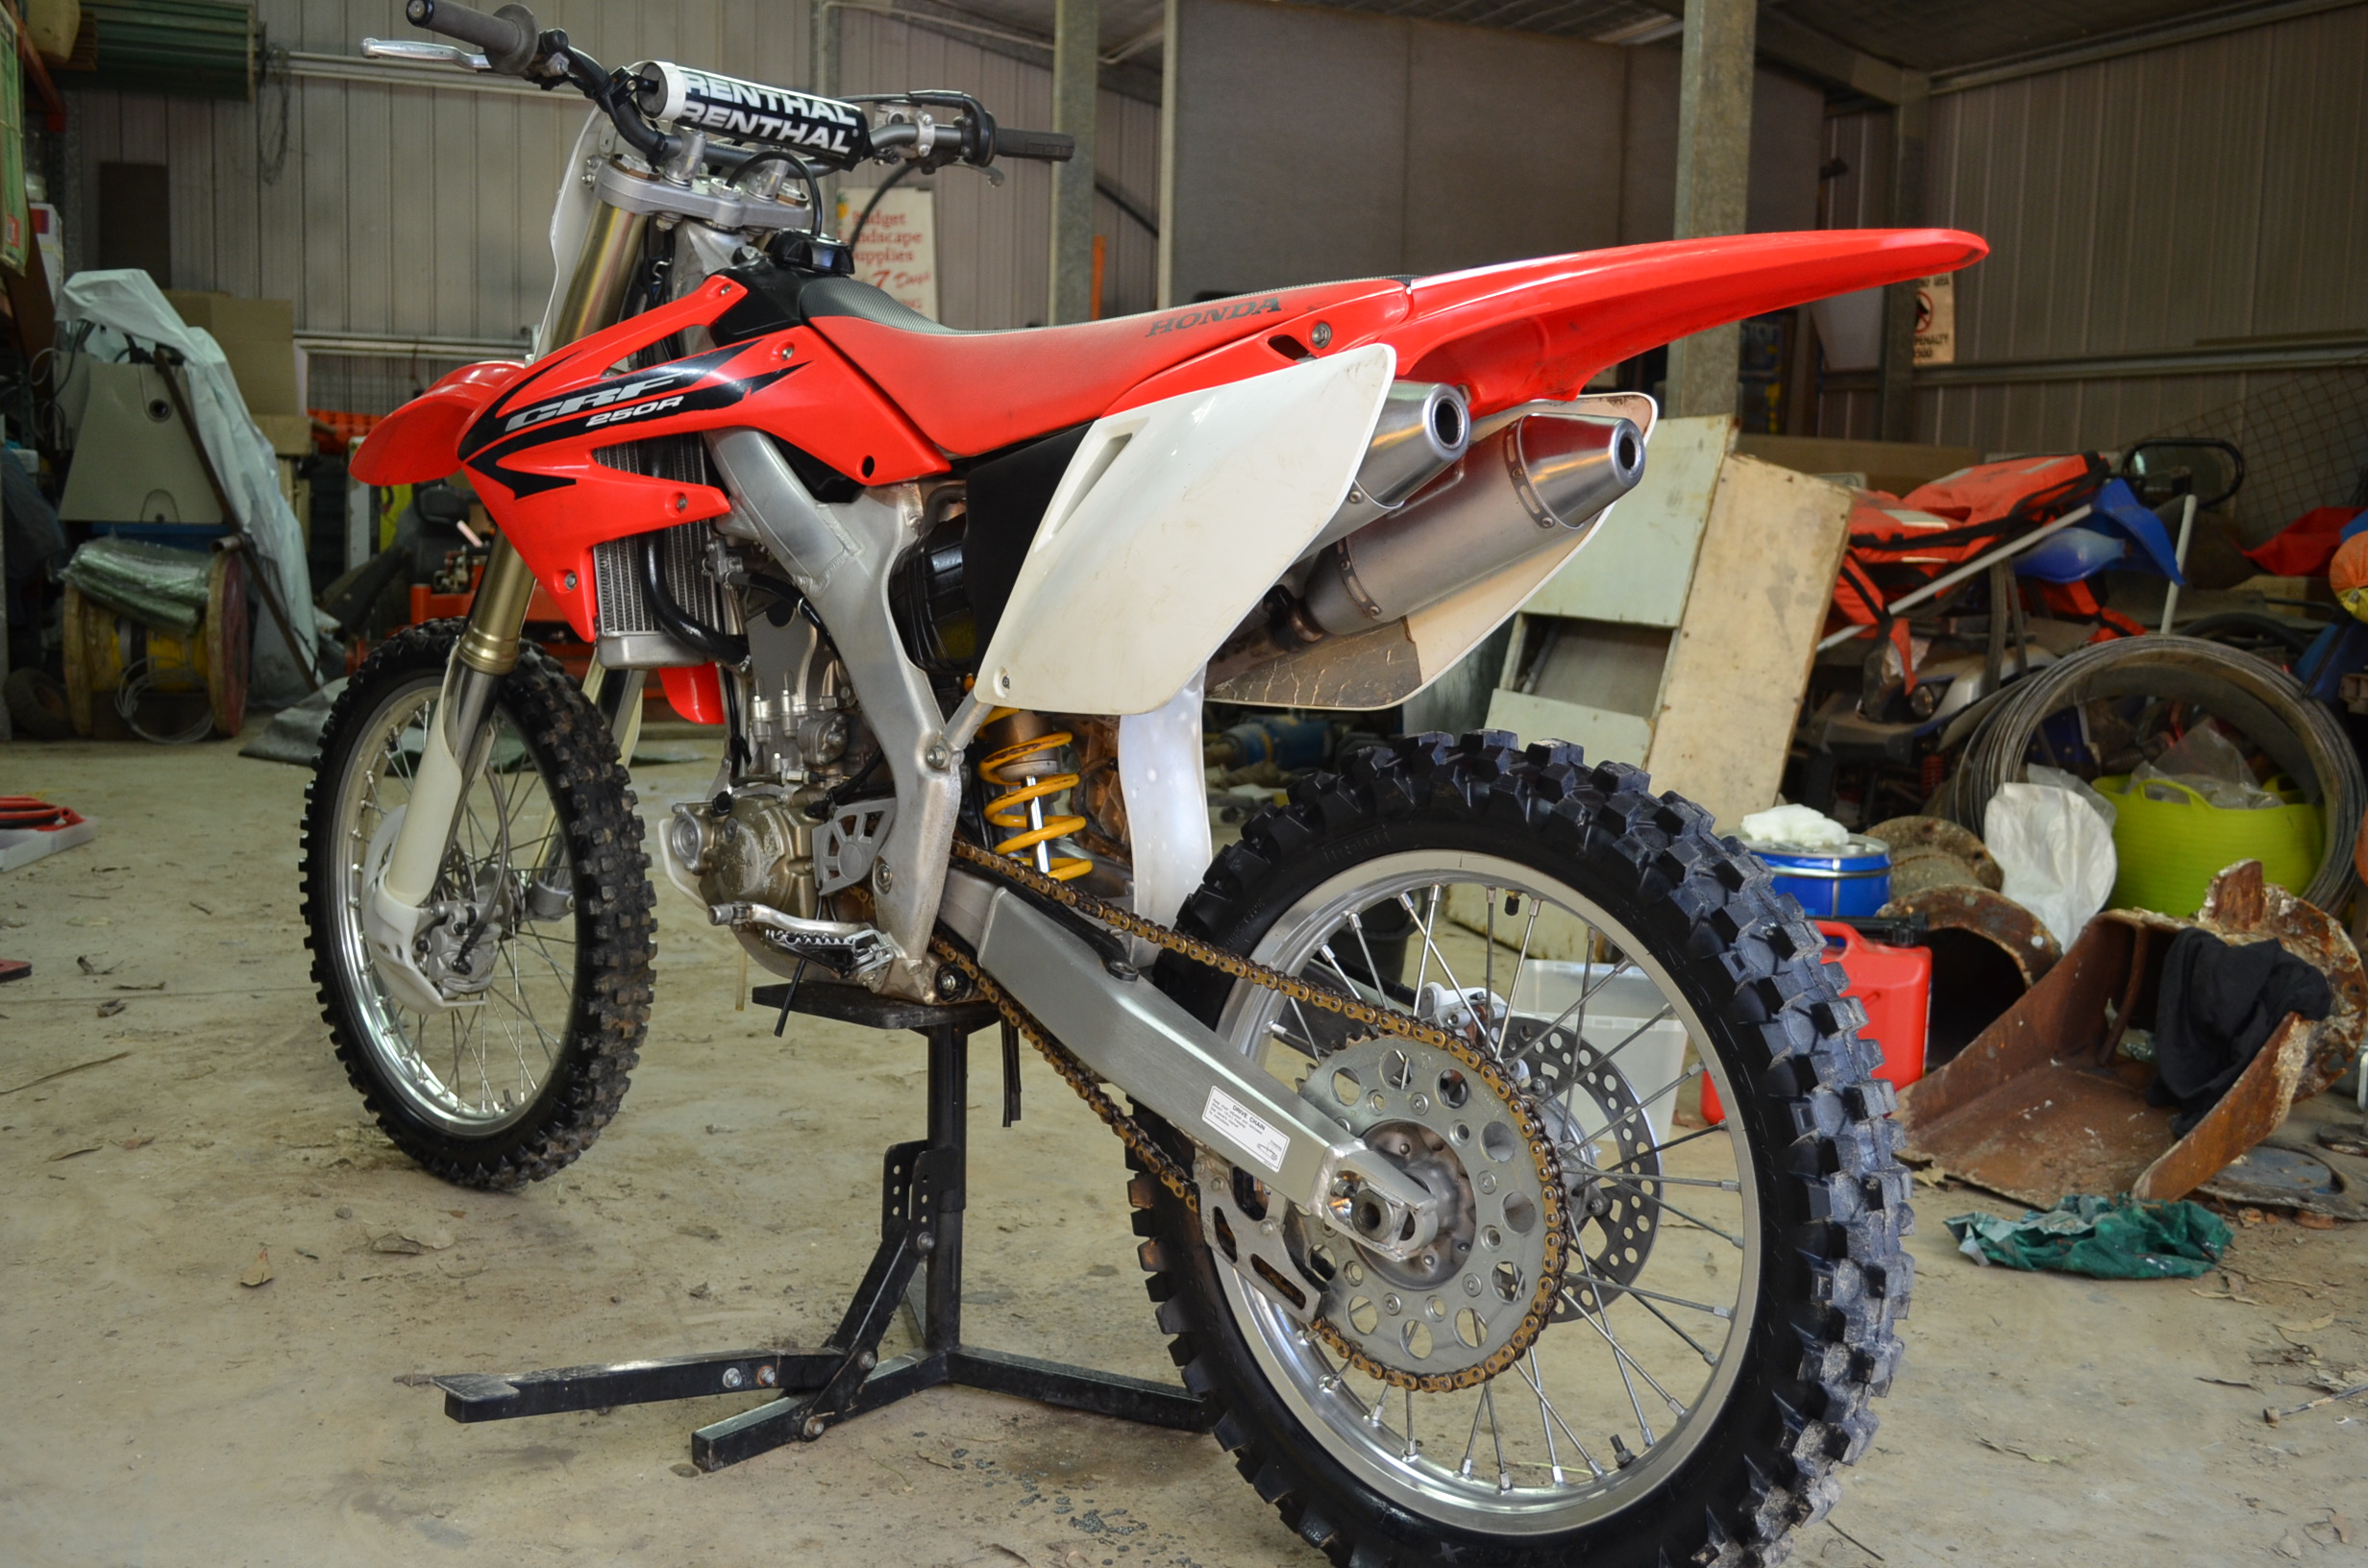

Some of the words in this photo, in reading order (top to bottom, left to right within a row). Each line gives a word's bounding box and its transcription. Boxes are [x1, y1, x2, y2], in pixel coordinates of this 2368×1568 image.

[683, 72, 858, 127] RENTHAL
[678, 99, 852, 155] RENTHAL
[837, 229, 924, 247] Lndscape
[872, 270, 891, 288] 7
[1145, 297, 1282, 338] HONDA
[505, 371, 684, 432] CRF
[585, 395, 684, 428] 250R
[1232, 1104, 1248, 1119] DRIVE
[1248, 1116, 1266, 1132] CHAIN
